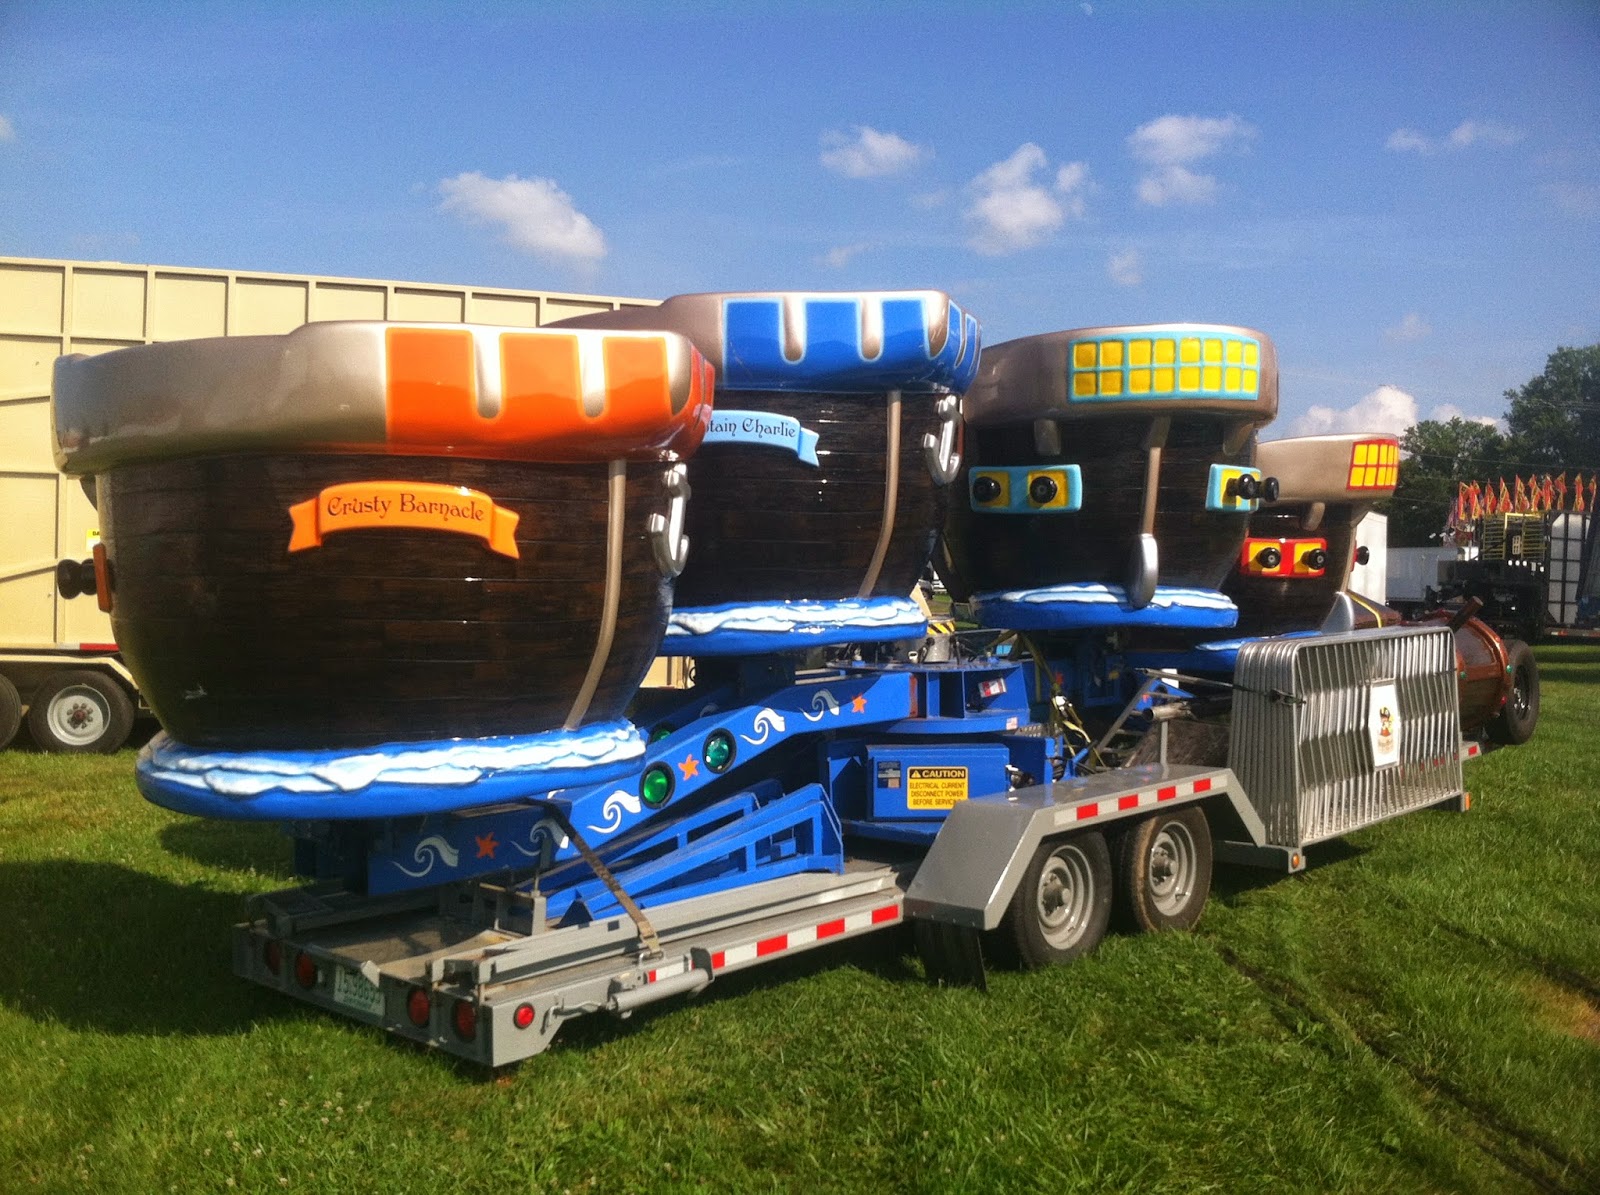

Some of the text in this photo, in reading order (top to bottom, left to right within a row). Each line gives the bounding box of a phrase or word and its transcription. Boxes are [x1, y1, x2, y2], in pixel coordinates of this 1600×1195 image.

[742, 418, 796, 439] Charlie
[327, 493, 485, 521] Crusty Barnacle
[922, 770, 965, 778] CAUTION
[912, 798, 933, 806] BEFORE
